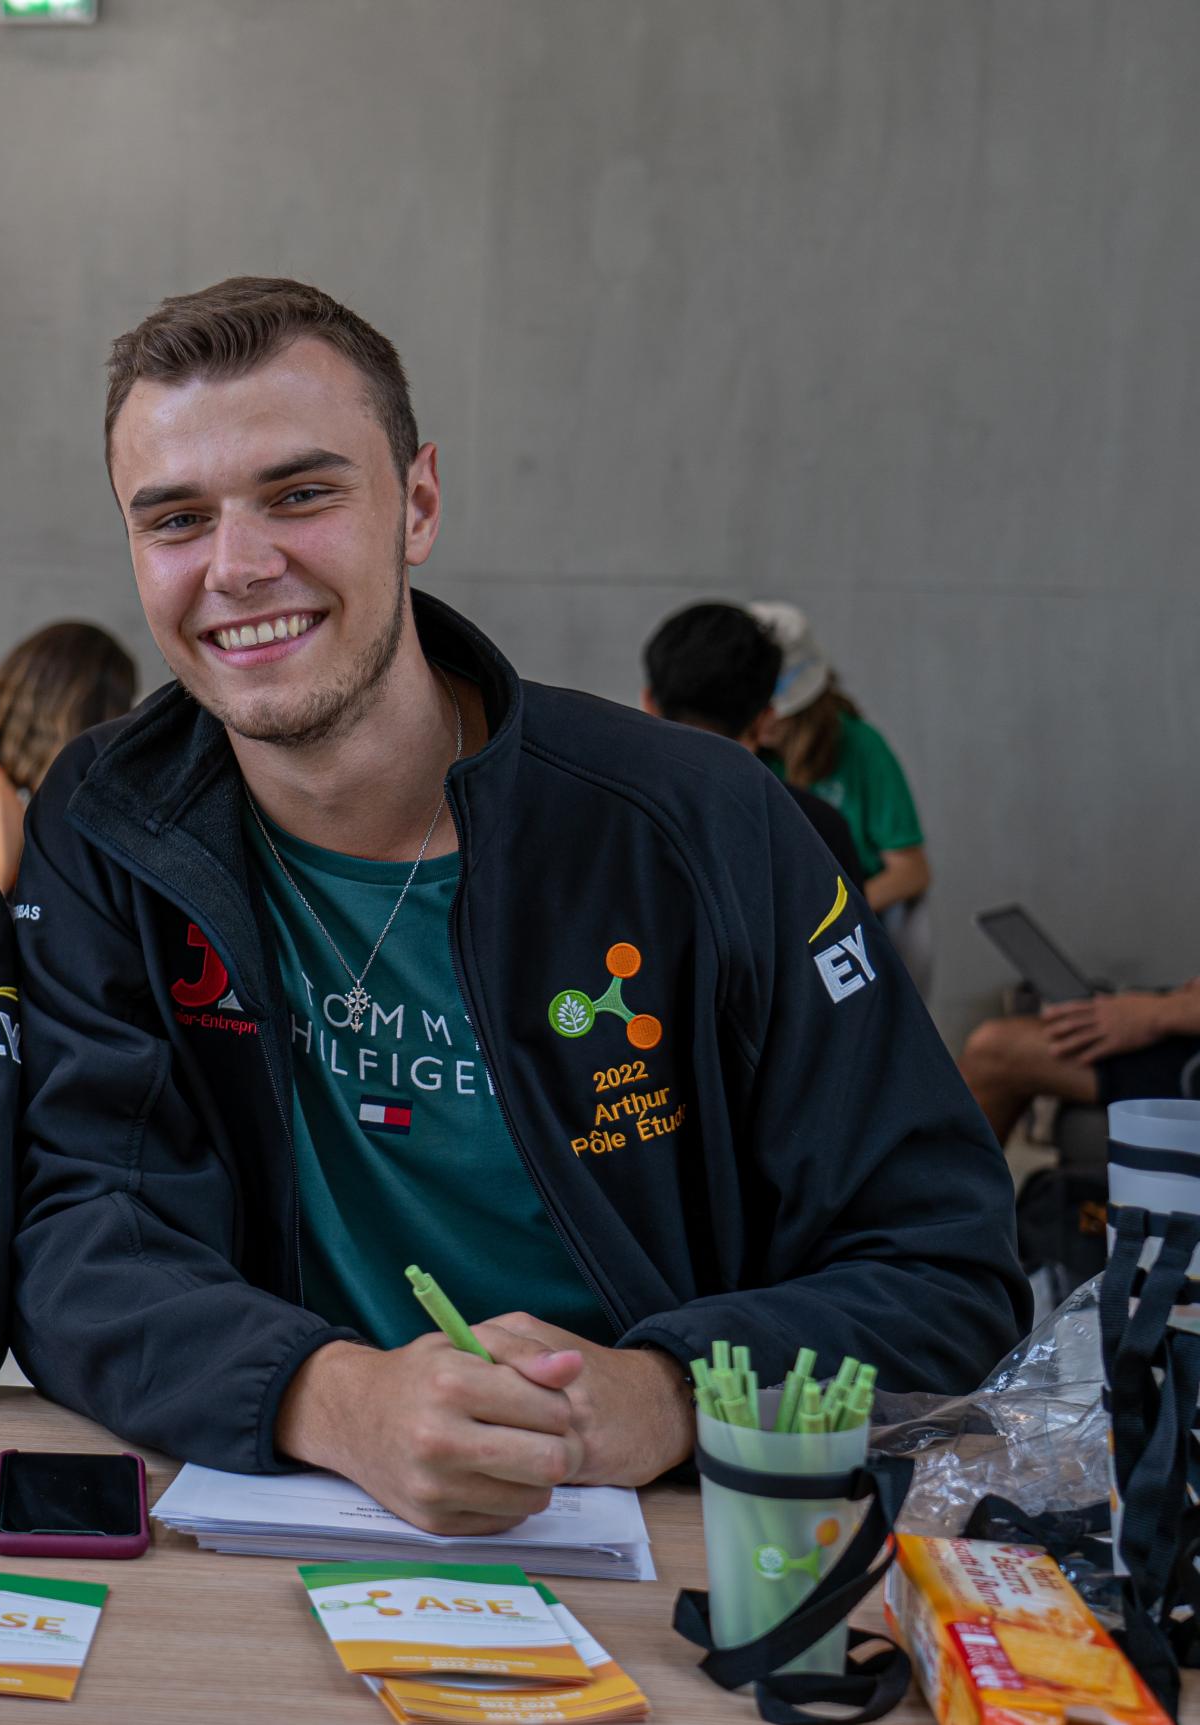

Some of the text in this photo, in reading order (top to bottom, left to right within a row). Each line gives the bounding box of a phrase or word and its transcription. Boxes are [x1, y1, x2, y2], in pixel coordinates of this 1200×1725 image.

[813, 923, 877, 1005] EY
[301, 971, 481, 1051] TOMM
[291, 1014, 495, 1095] HILFIGE
[592, 1060, 649, 1094] 2022
[594, 1087, 670, 1126] Arthur
[570, 1130, 627, 1159] Pôle
[415, 1595, 521, 1617] ASE
